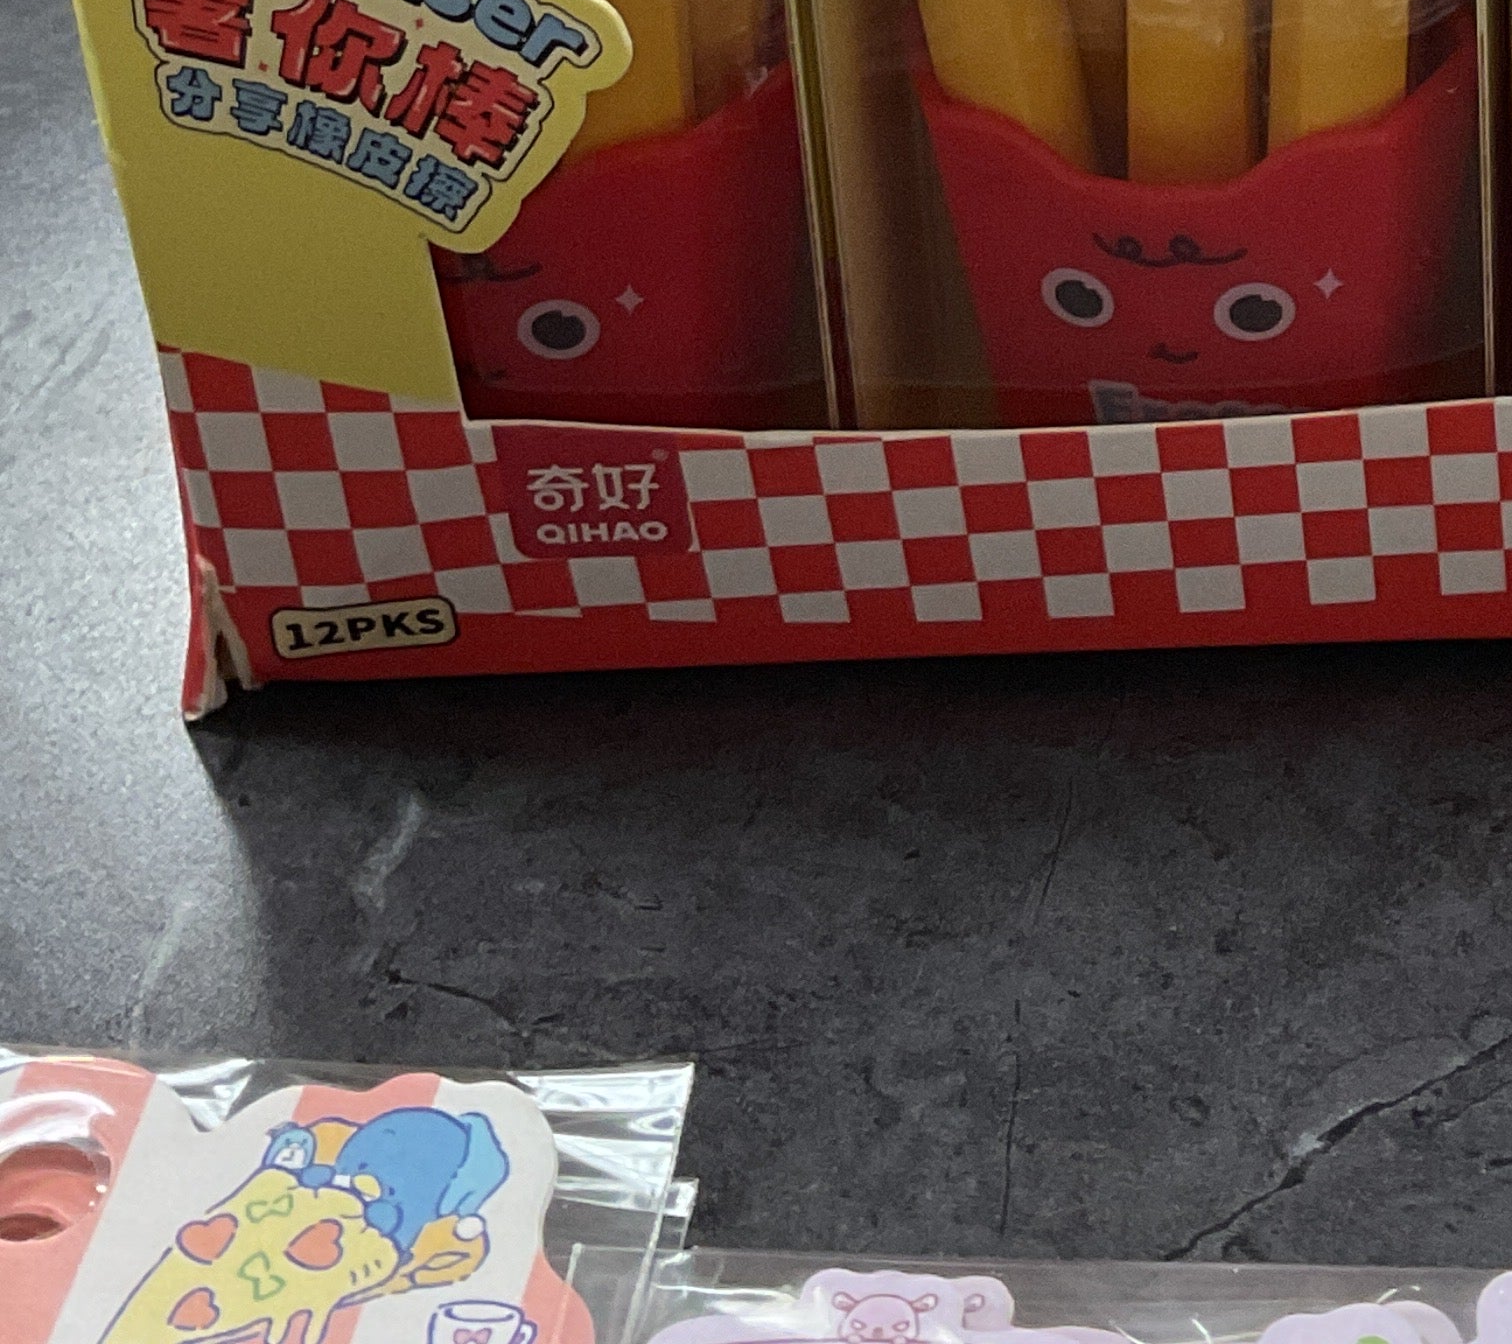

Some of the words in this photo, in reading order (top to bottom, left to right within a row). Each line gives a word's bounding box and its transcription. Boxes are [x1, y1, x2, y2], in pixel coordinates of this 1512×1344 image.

[167, 66, 479, 222] 分享橡皮擦
[526, 463, 660, 512] 奇好
[536, 521, 668, 544] QIHAO
[285, 608, 446, 652] 12PKS
